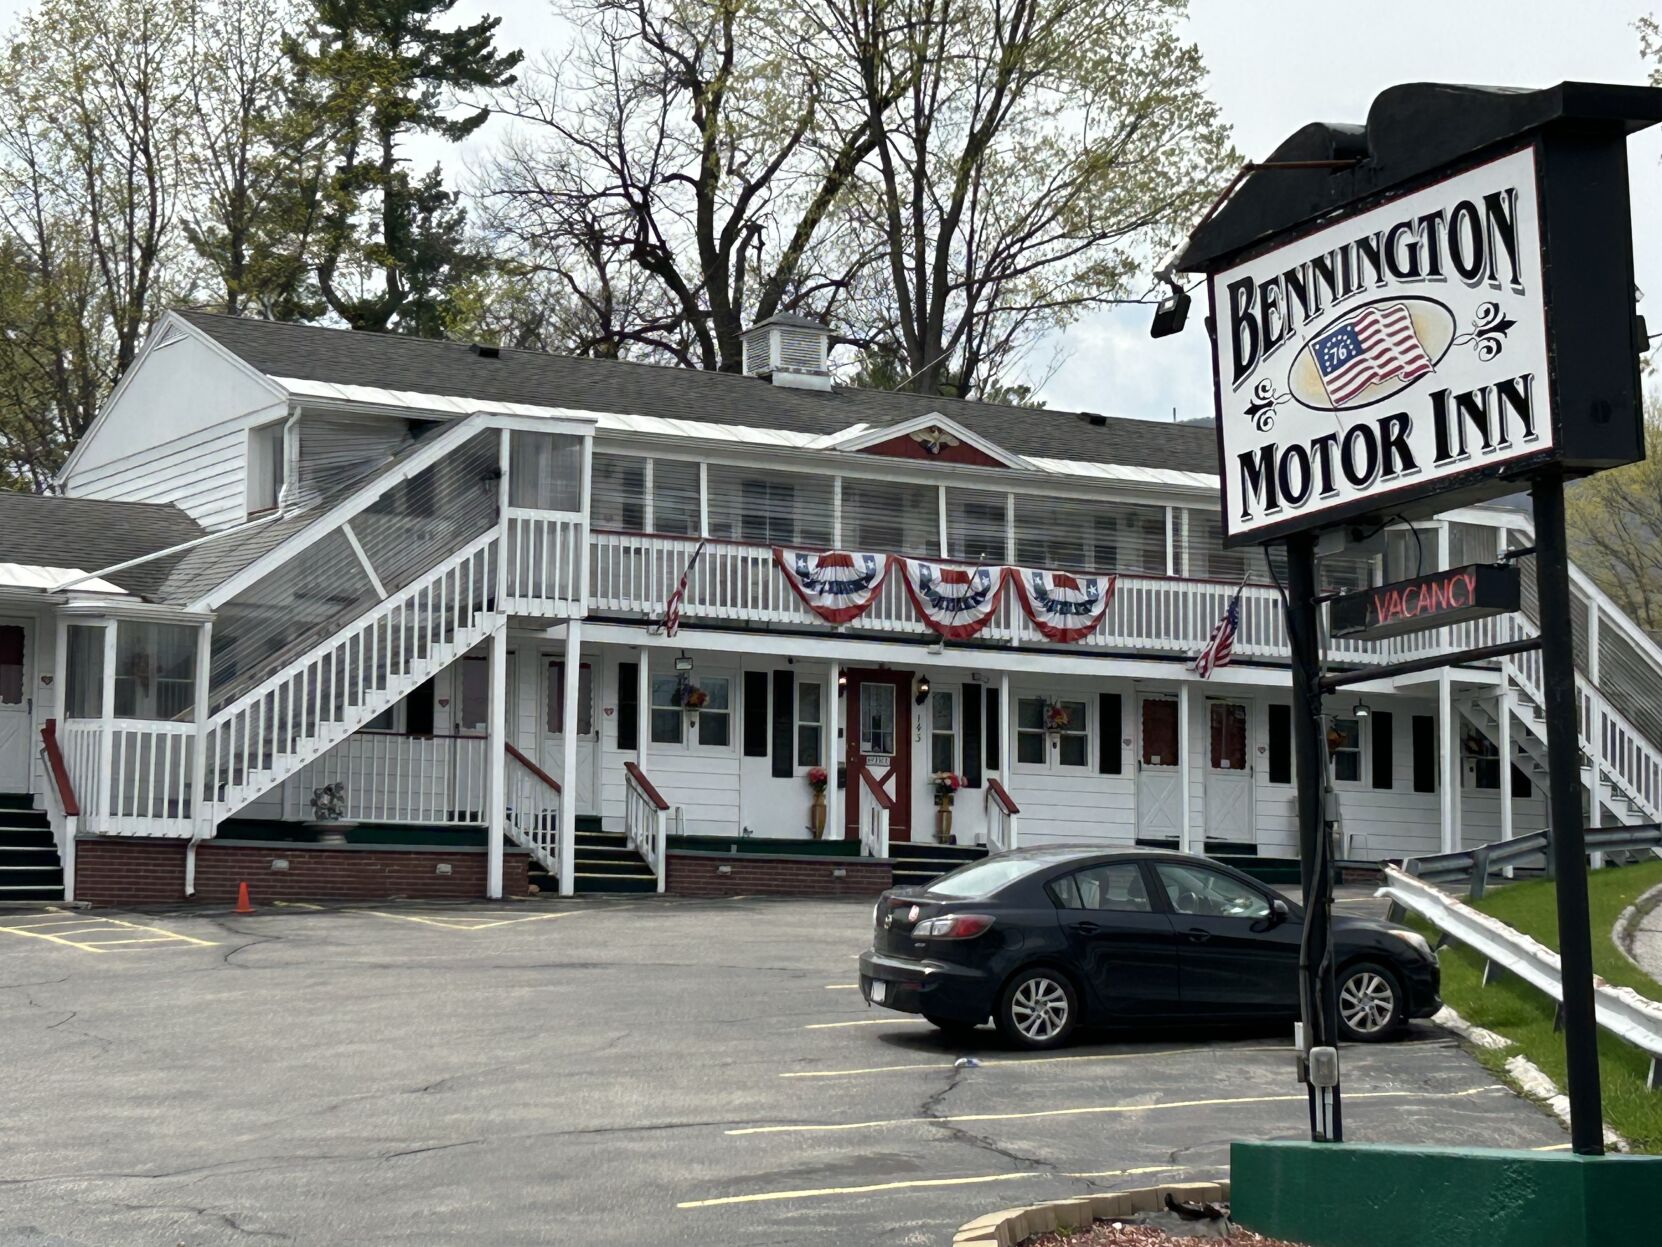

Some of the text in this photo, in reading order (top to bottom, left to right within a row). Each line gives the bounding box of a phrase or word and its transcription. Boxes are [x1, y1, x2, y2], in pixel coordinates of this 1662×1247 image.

[1226, 187, 1525, 392] BENNINGTON
[1329, 342, 1347, 365] 76
[1237, 373, 1539, 522] MOTOR INN
[1374, 573, 1476, 625] VACANCY
